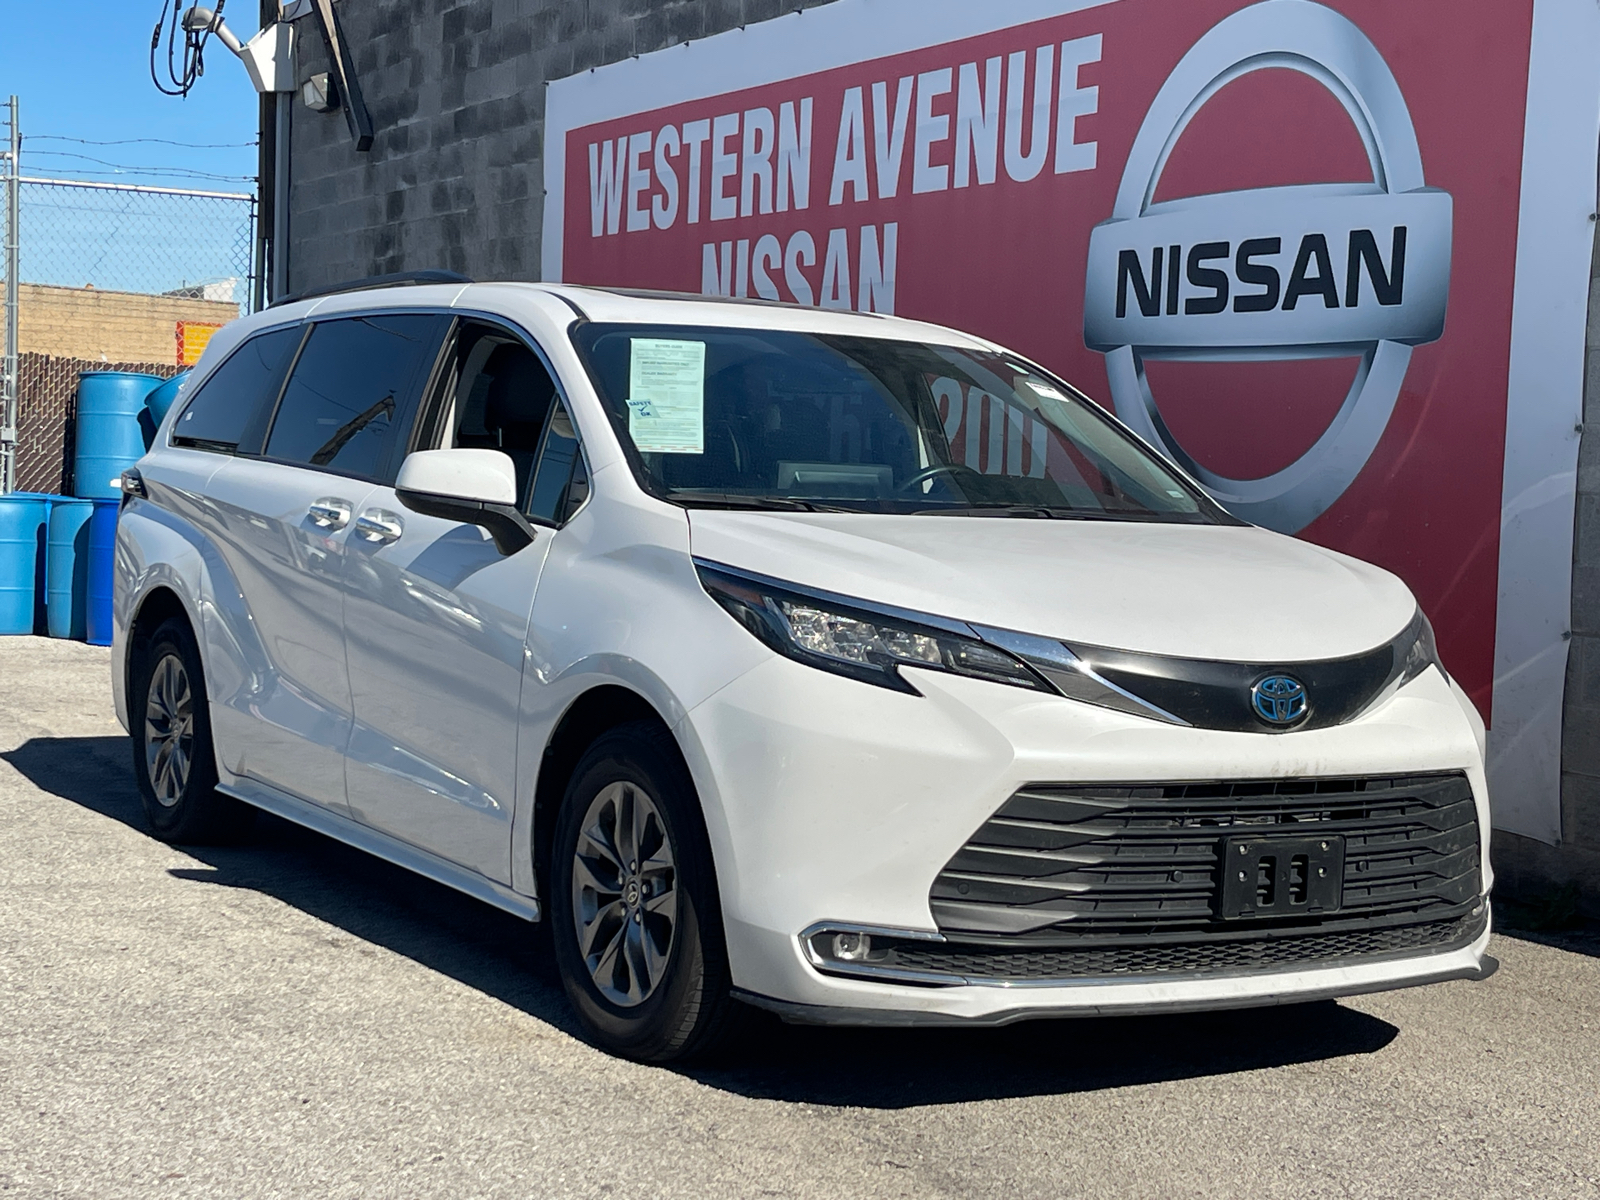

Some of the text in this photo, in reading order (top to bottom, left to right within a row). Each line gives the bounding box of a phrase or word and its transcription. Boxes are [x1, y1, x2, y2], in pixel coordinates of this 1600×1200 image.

[588, 33, 1103, 238] WESTERN AVENUE
[702, 222, 898, 316] NISSAN
[1115, 226, 1407, 318] NISSAN
